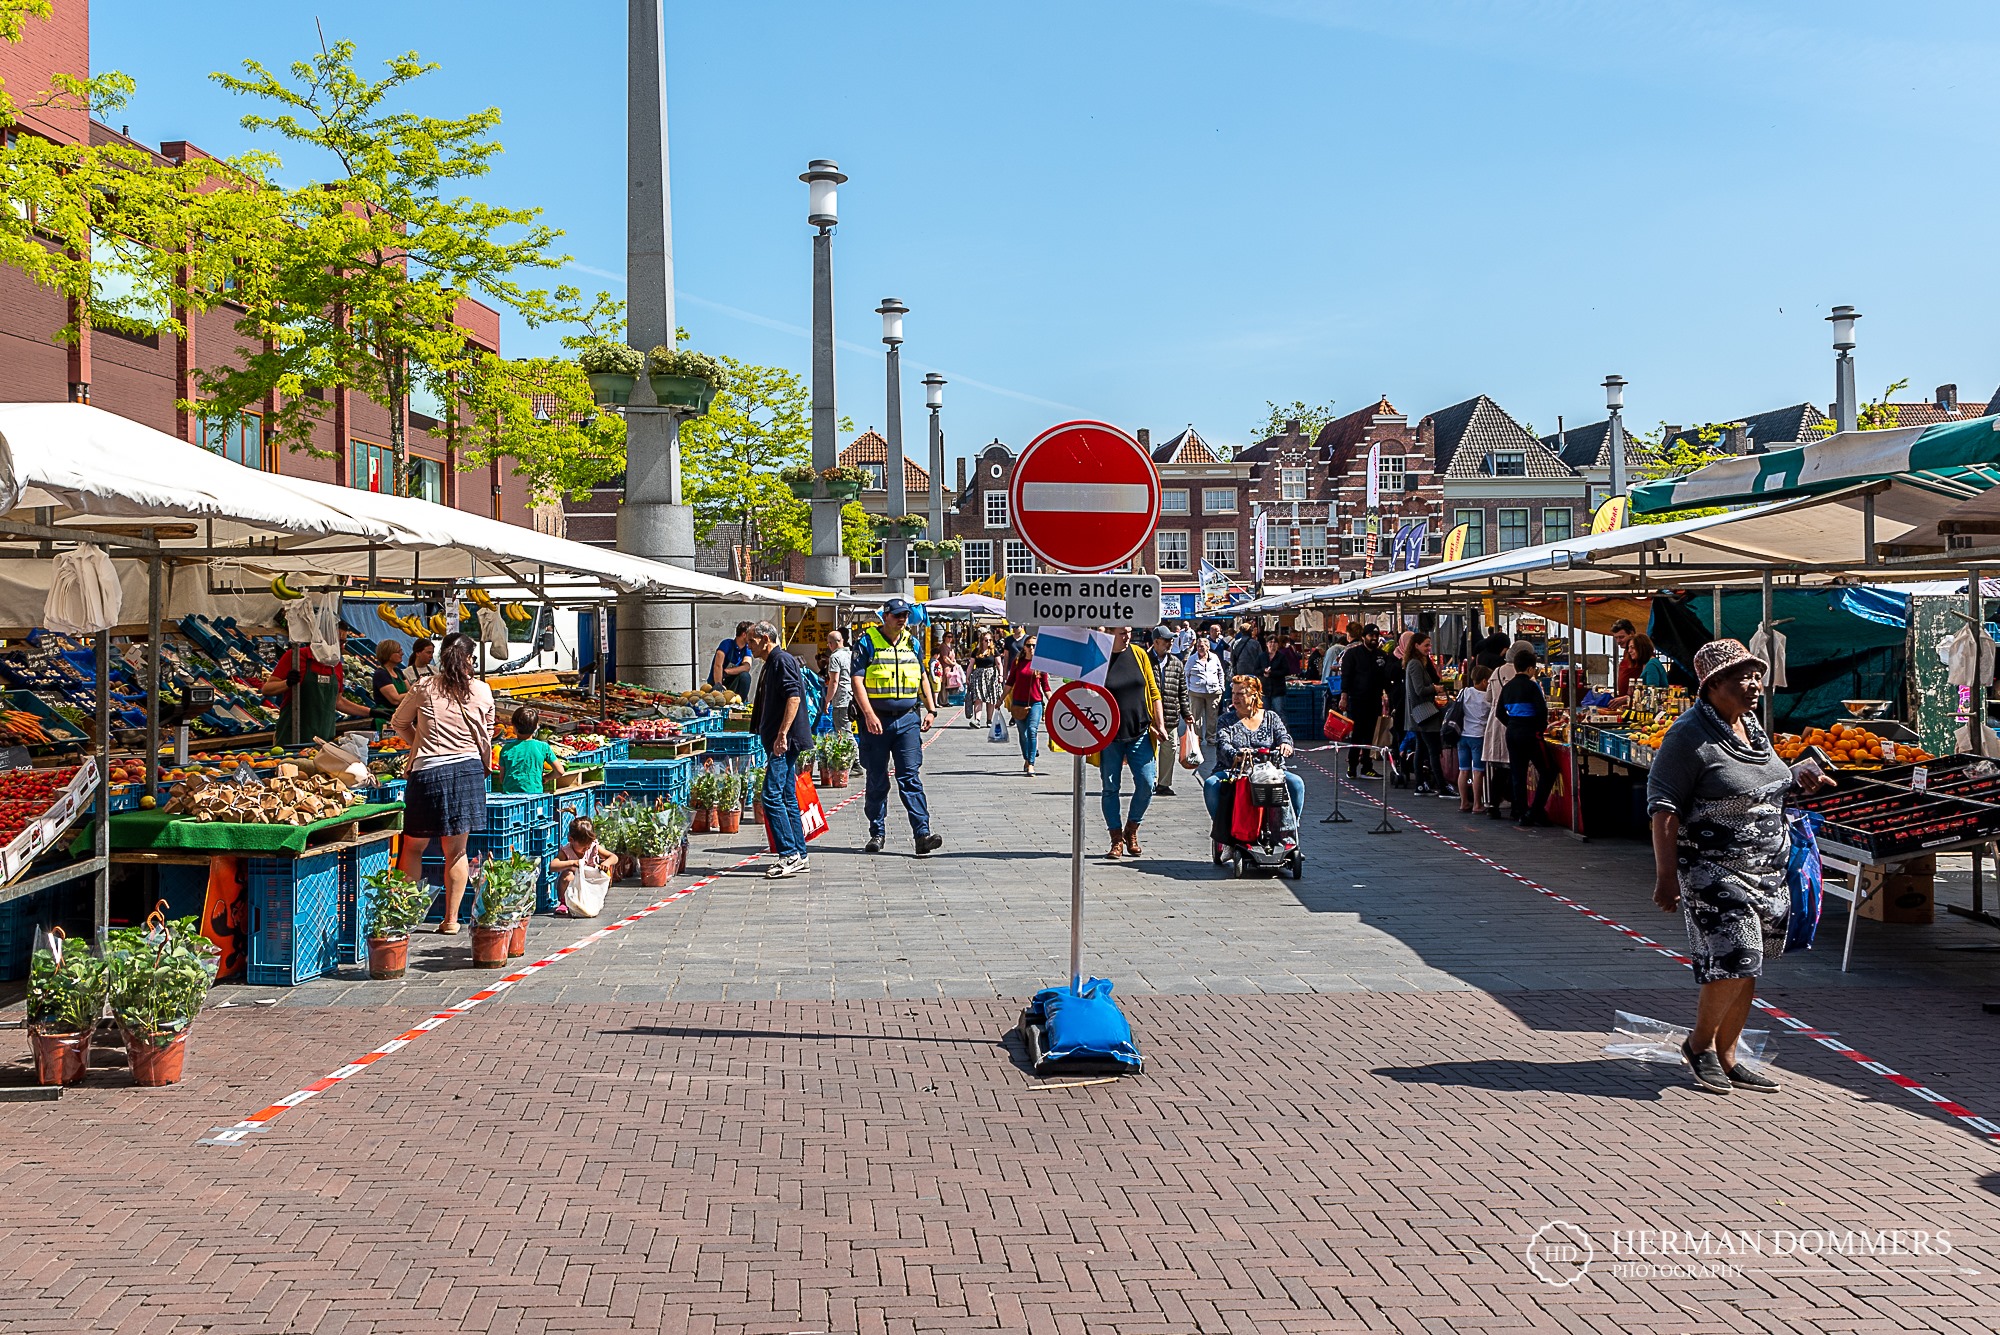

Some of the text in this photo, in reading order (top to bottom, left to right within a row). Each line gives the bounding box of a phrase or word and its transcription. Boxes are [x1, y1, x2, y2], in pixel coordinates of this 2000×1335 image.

[1015, 579, 1153, 598] neem andere
[1033, 600, 1134, 622] looproute
[800, 802, 824, 837] irk
